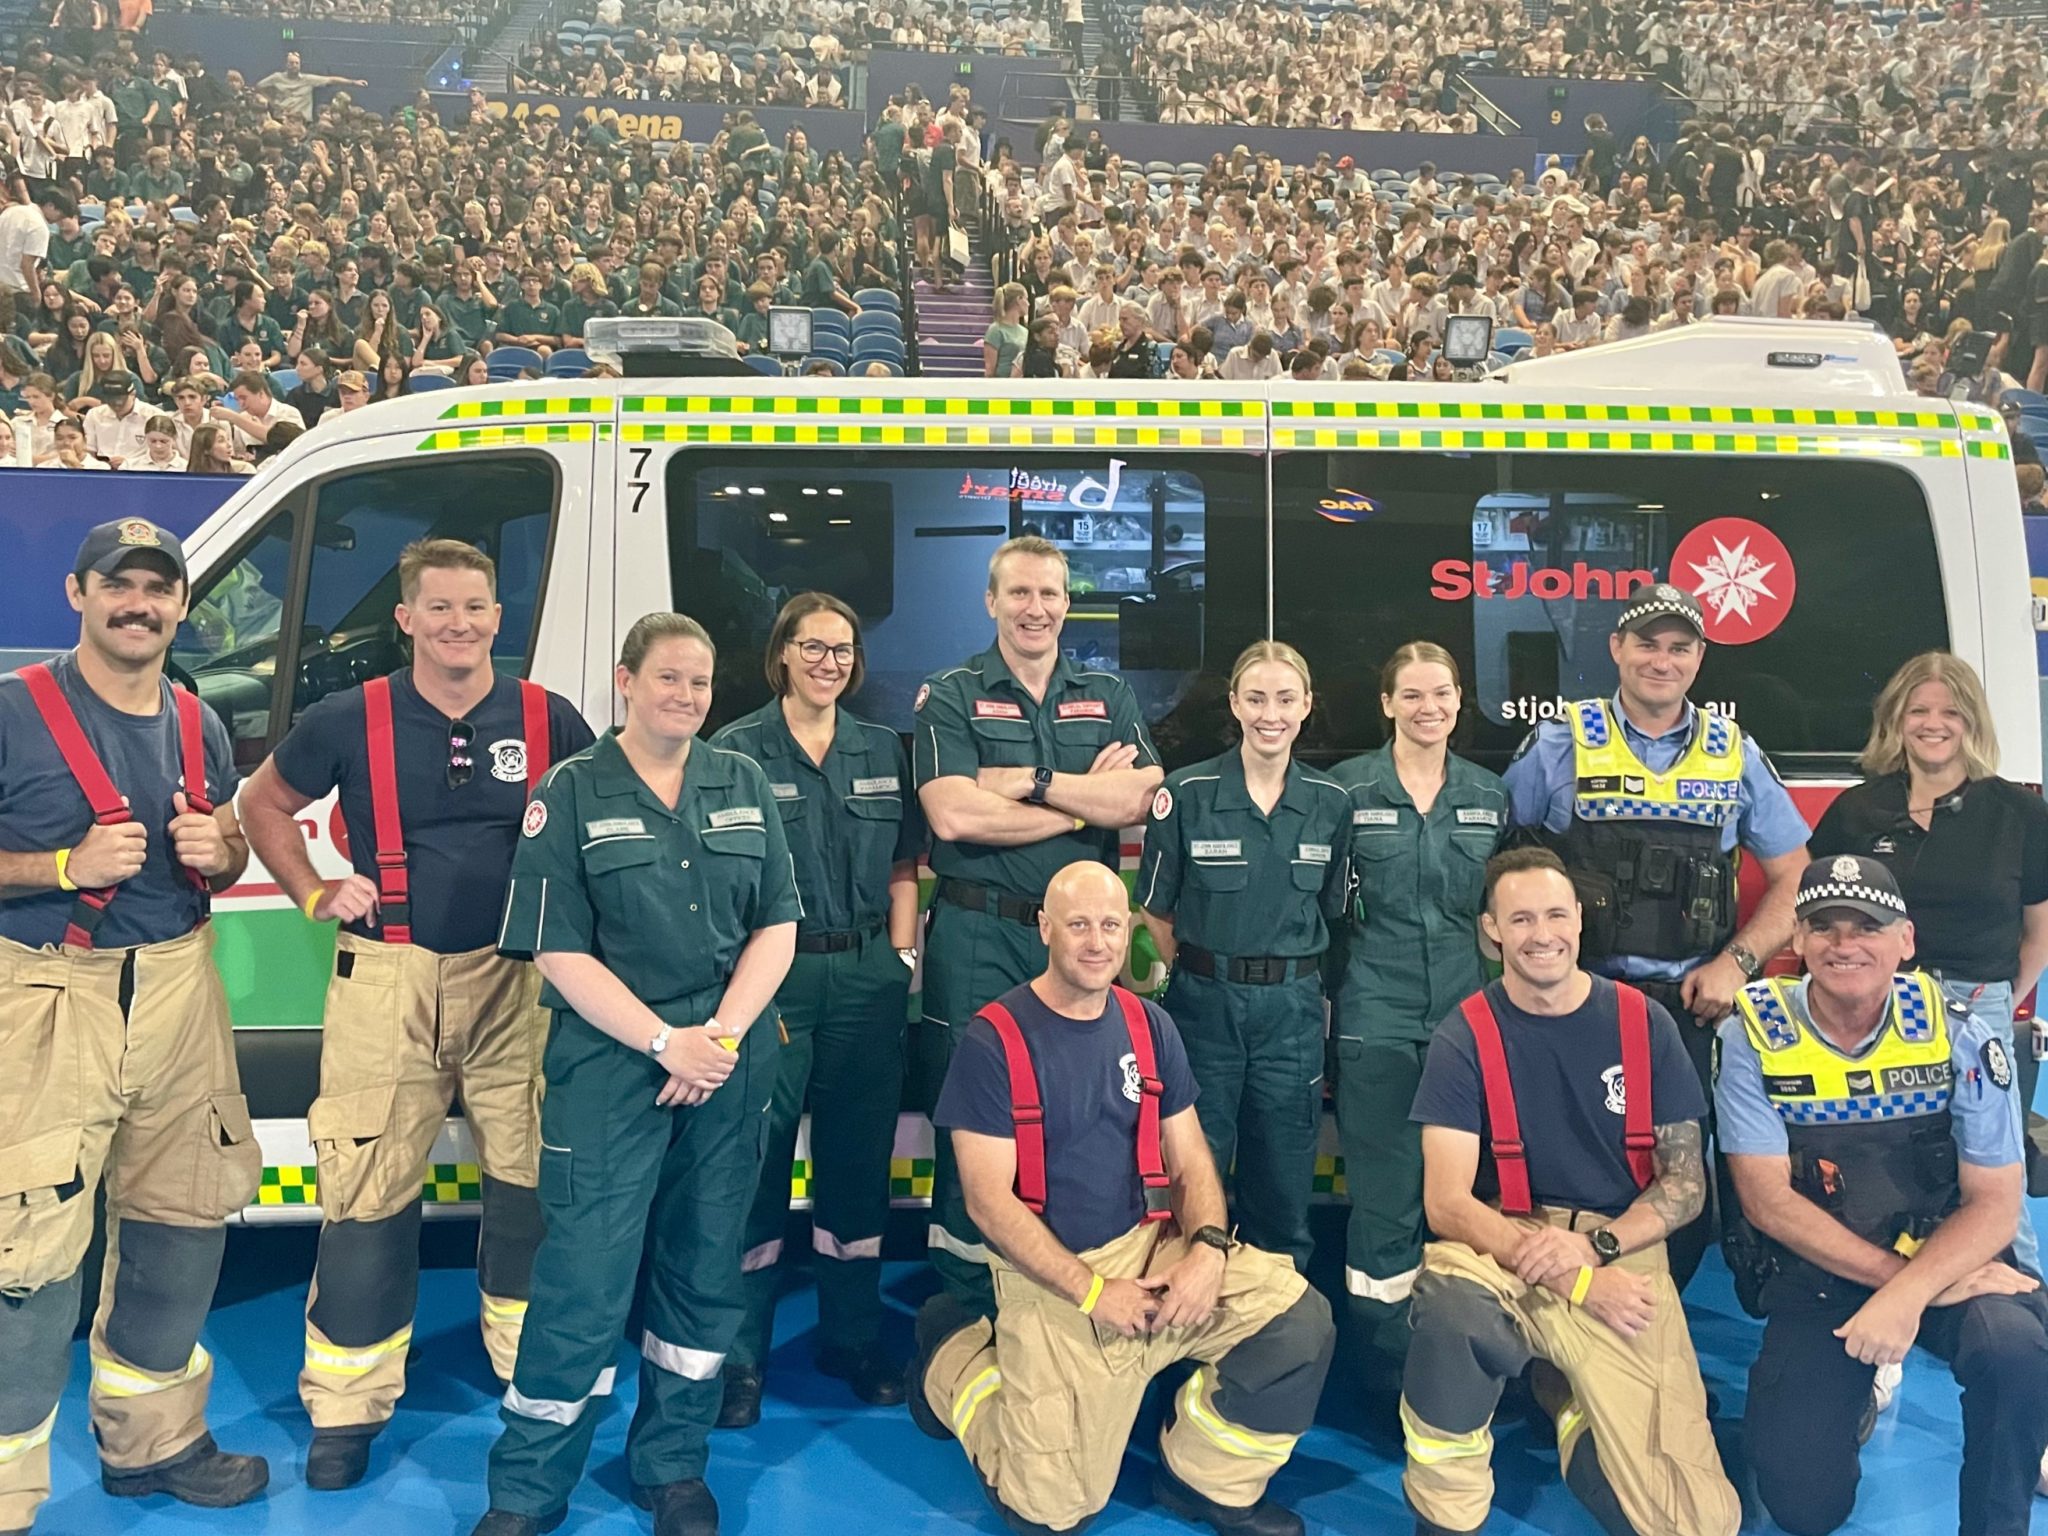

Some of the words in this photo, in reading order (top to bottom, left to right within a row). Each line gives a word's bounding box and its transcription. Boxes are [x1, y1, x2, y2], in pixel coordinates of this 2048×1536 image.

[1551, 110, 1562, 125] 9
[1078, 521, 1089, 531] 15
[1477, 523, 1488, 533] 17
[1680, 781, 1739, 799] POLICE
[1888, 1066, 1951, 1089] POLICE
